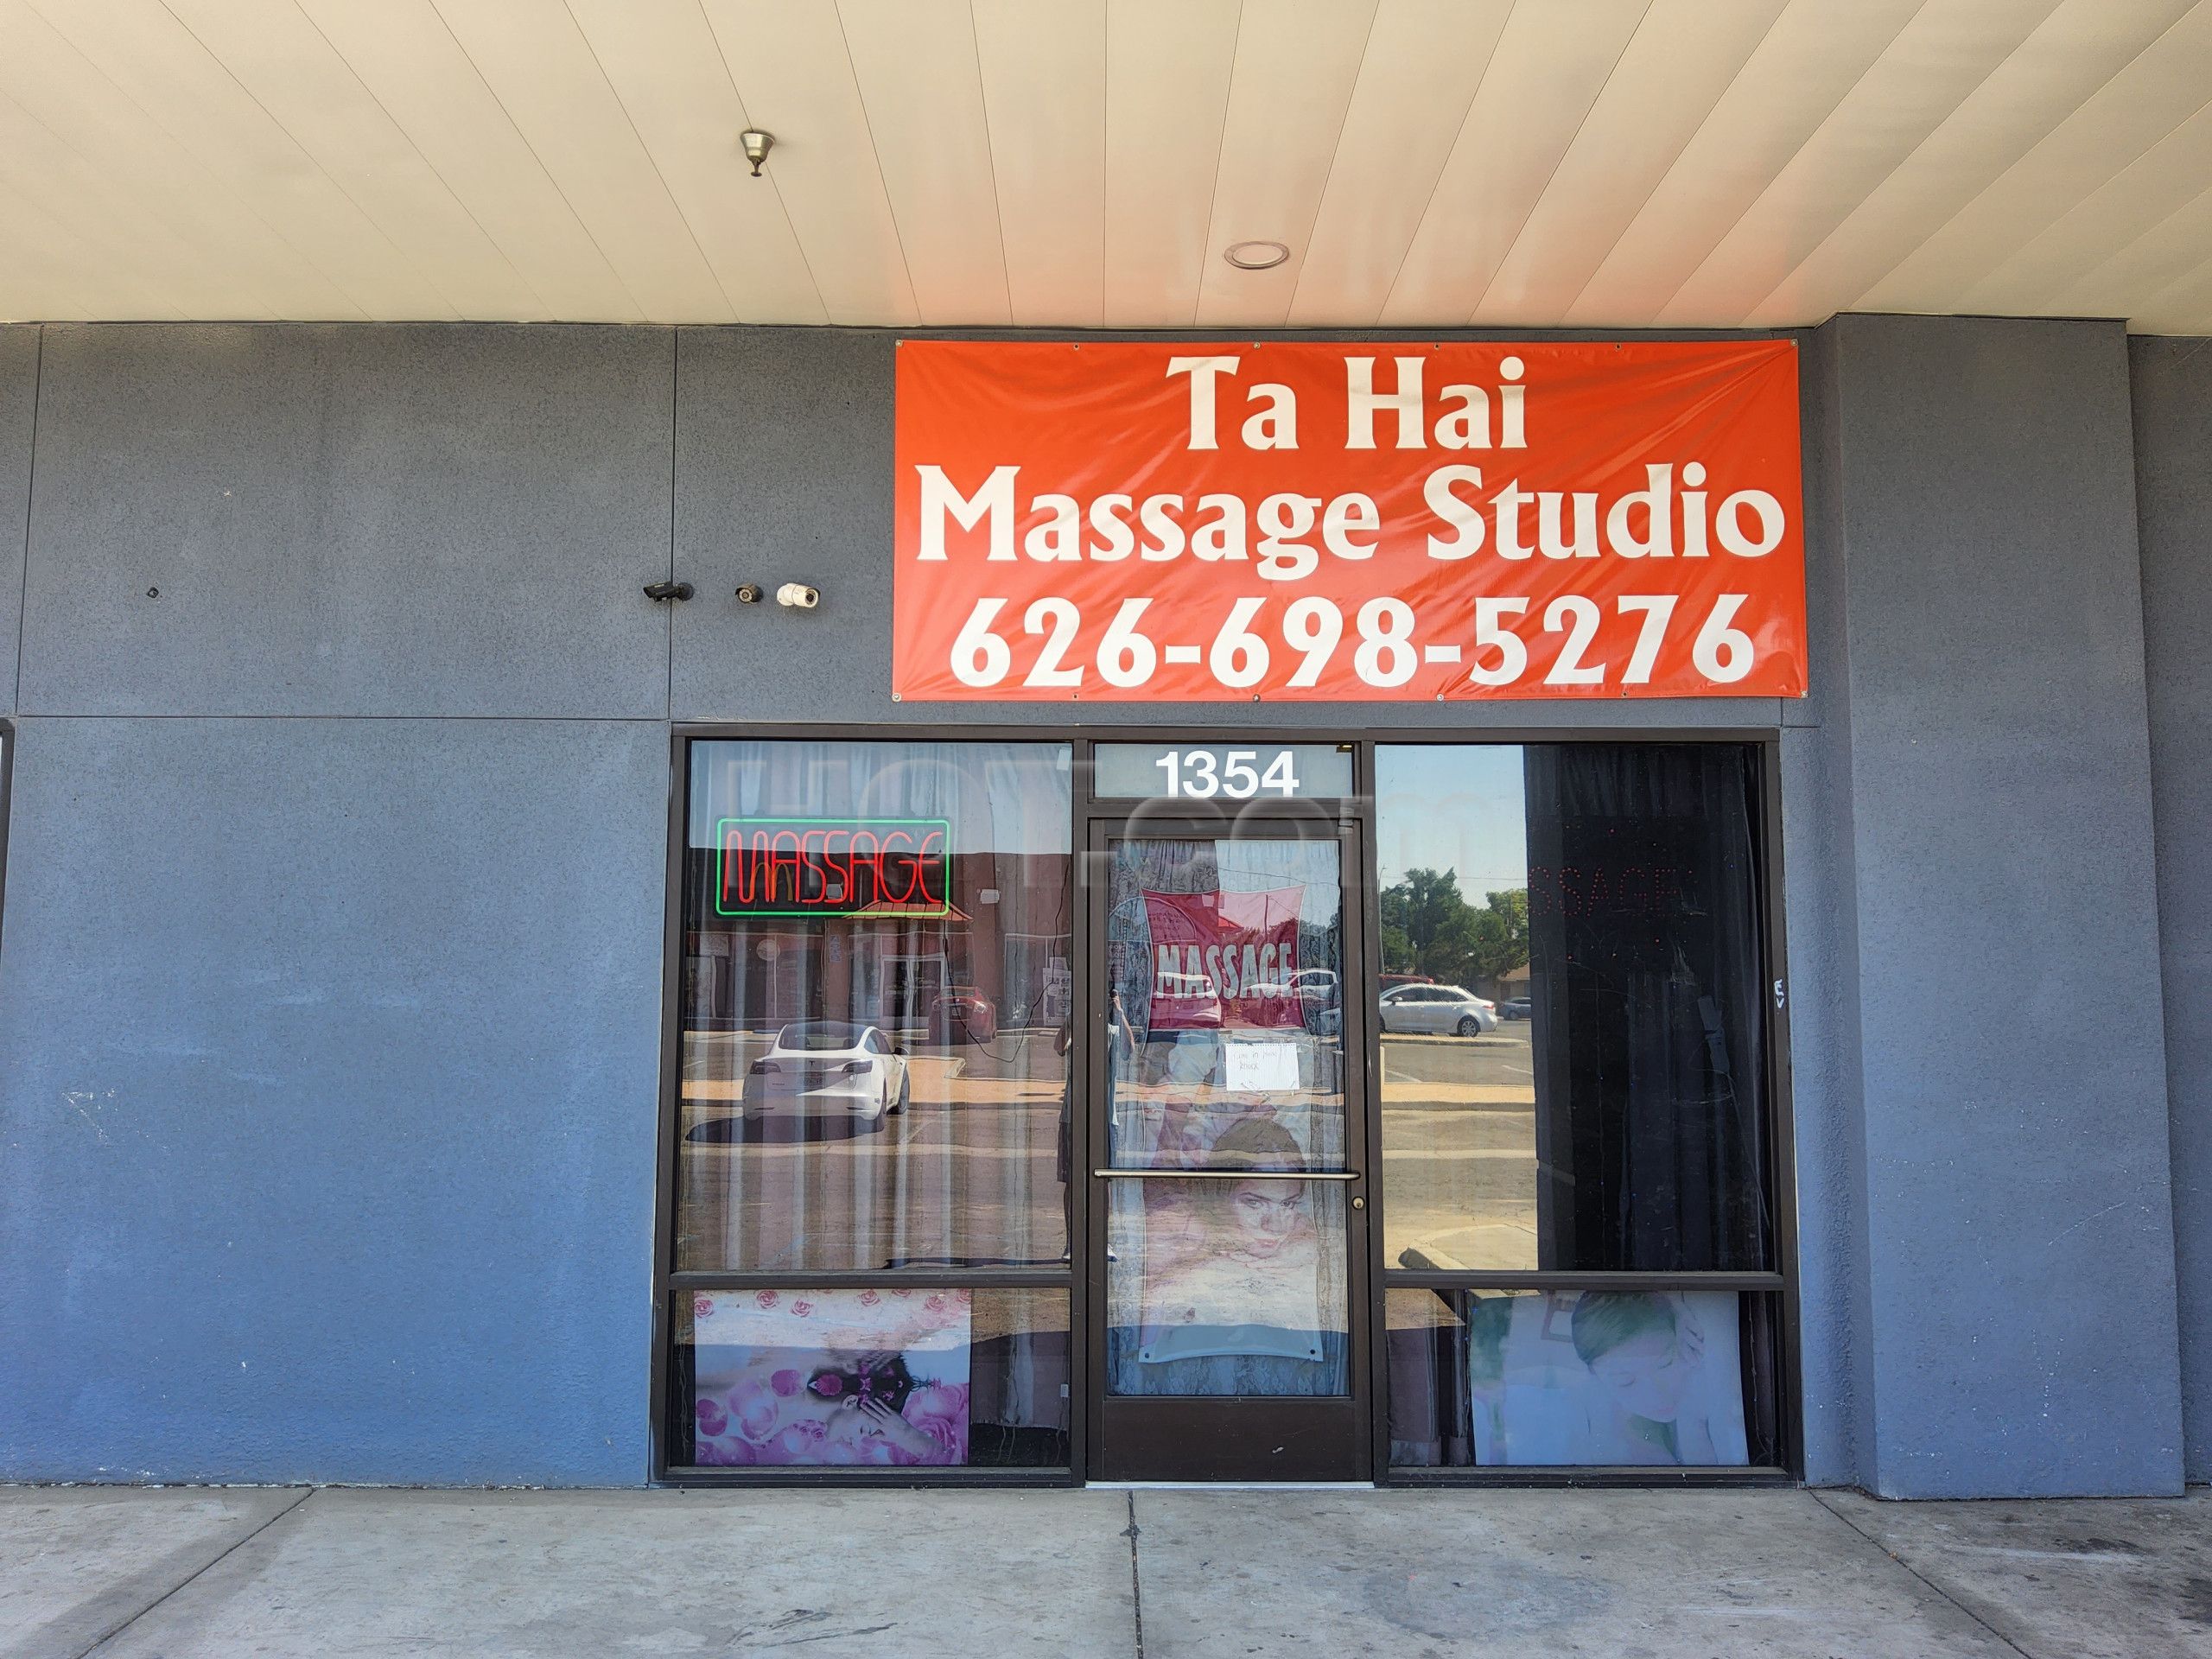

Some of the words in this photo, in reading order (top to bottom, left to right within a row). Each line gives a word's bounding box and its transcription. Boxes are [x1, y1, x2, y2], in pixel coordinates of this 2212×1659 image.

[1166, 356, 1300, 450] Ta
[1344, 356, 1528, 450] Hai
[914, 464, 1381, 582] Massage
[1423, 461, 1786, 562] Studio
[948, 593, 1756, 690] 626-698-5276
[1155, 750, 1300, 798] 1354
[722, 830, 944, 904] MASSAGE
[1155, 942, 1295, 1000] MASSAGE
